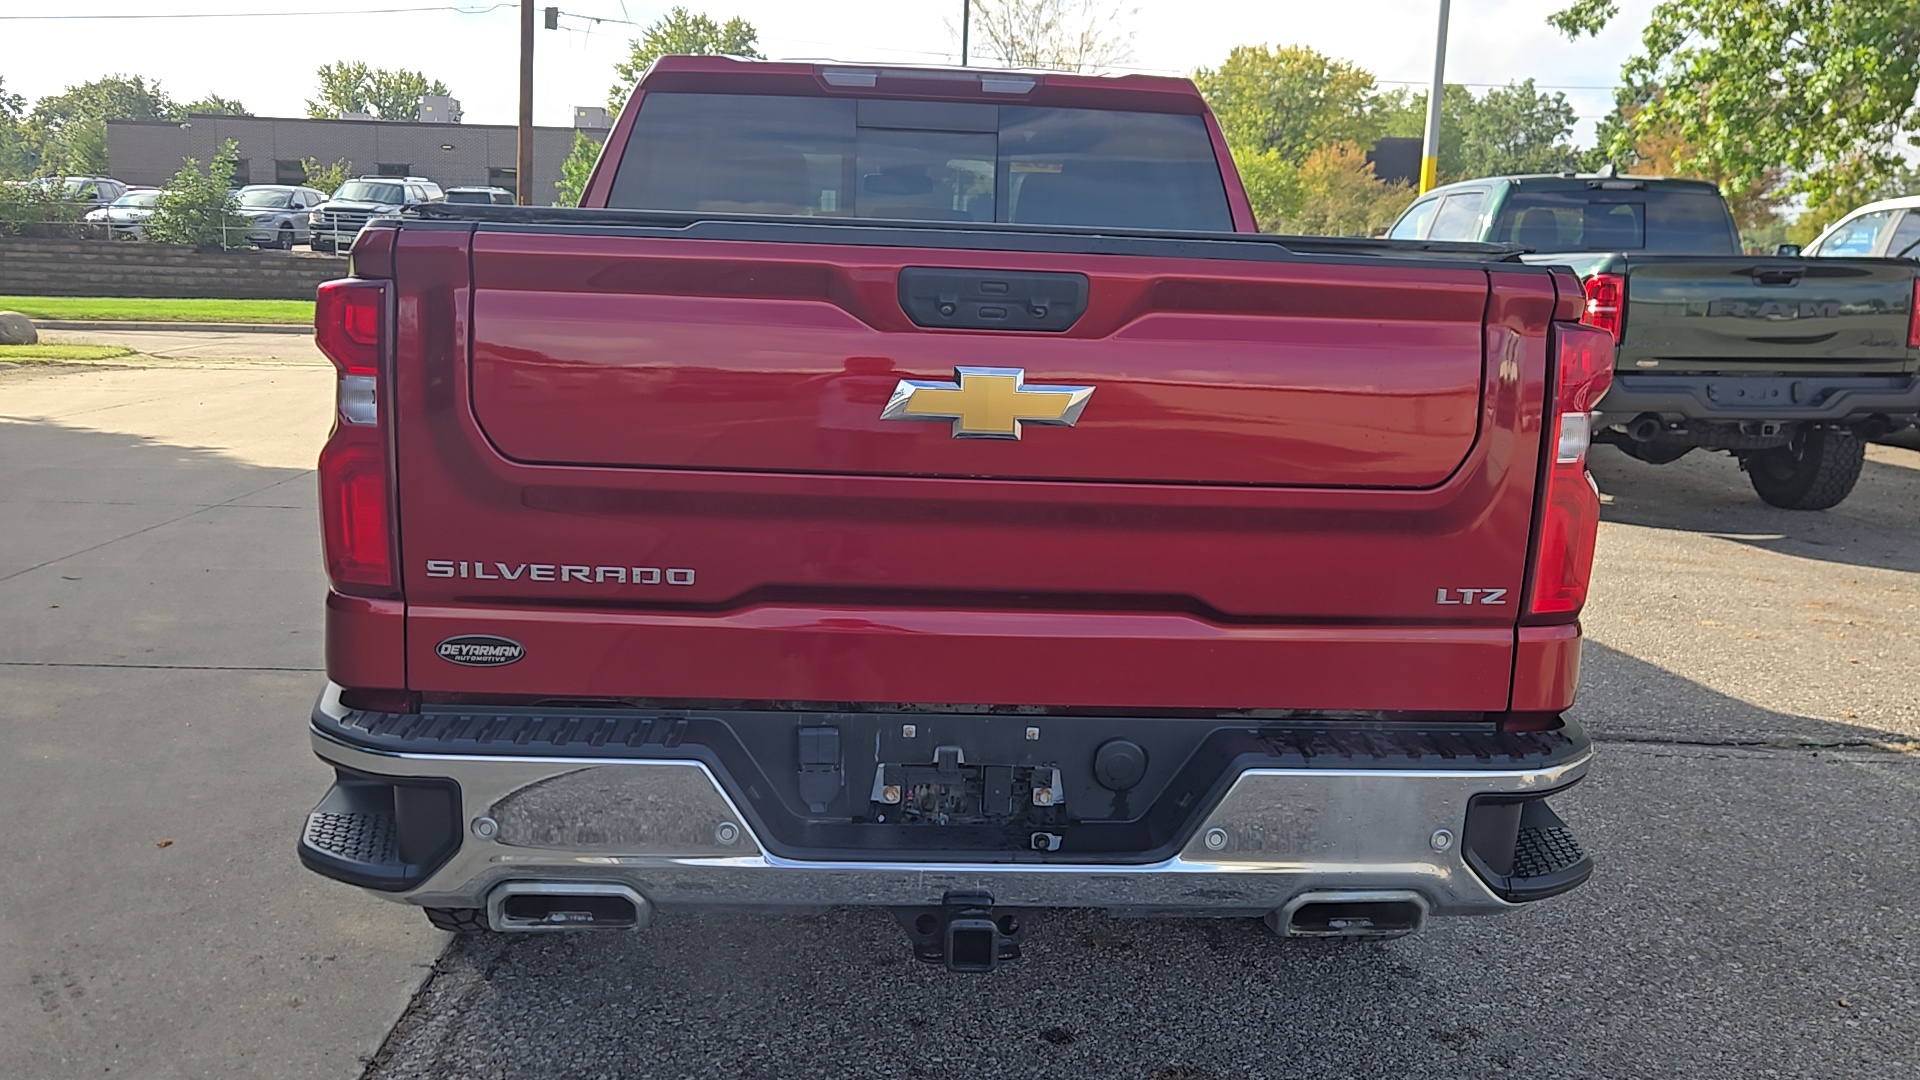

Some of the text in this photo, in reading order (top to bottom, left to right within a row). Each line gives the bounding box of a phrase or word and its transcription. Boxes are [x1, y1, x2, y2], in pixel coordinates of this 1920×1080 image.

[1708, 301, 1841, 318] RAM
[426, 560, 696, 585] SILVERADO
[1436, 588, 1507, 604] LTZ
[440, 643, 520, 657] DEYARMAN
